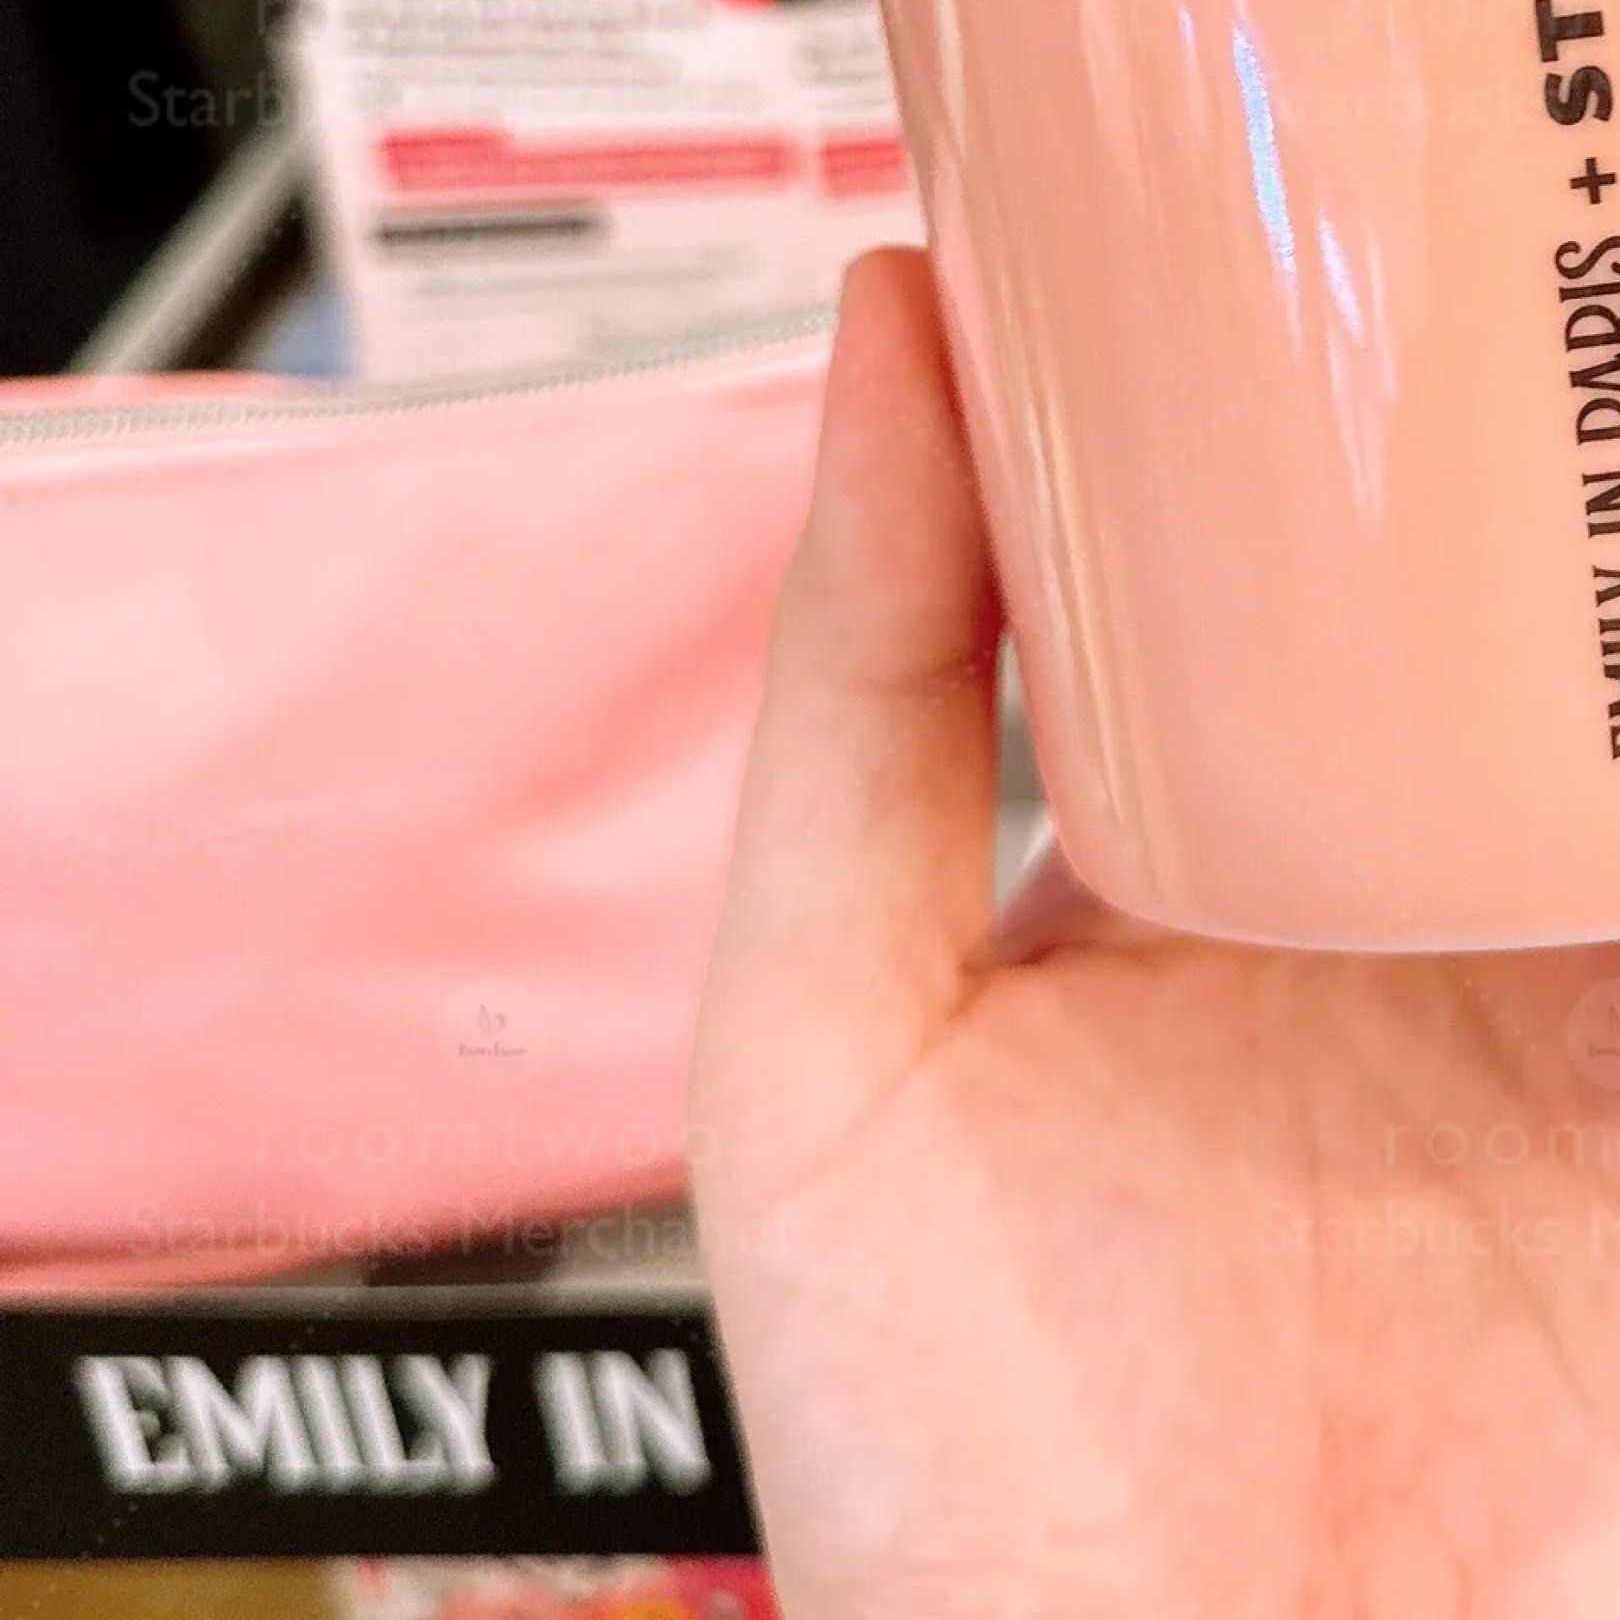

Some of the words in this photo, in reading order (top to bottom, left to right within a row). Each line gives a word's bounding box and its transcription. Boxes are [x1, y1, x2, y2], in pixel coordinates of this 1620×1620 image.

[1569, 157, 1616, 204] +
[76, 1355, 495, 1492] EMILY
[534, 1349, 711, 1493] IN
